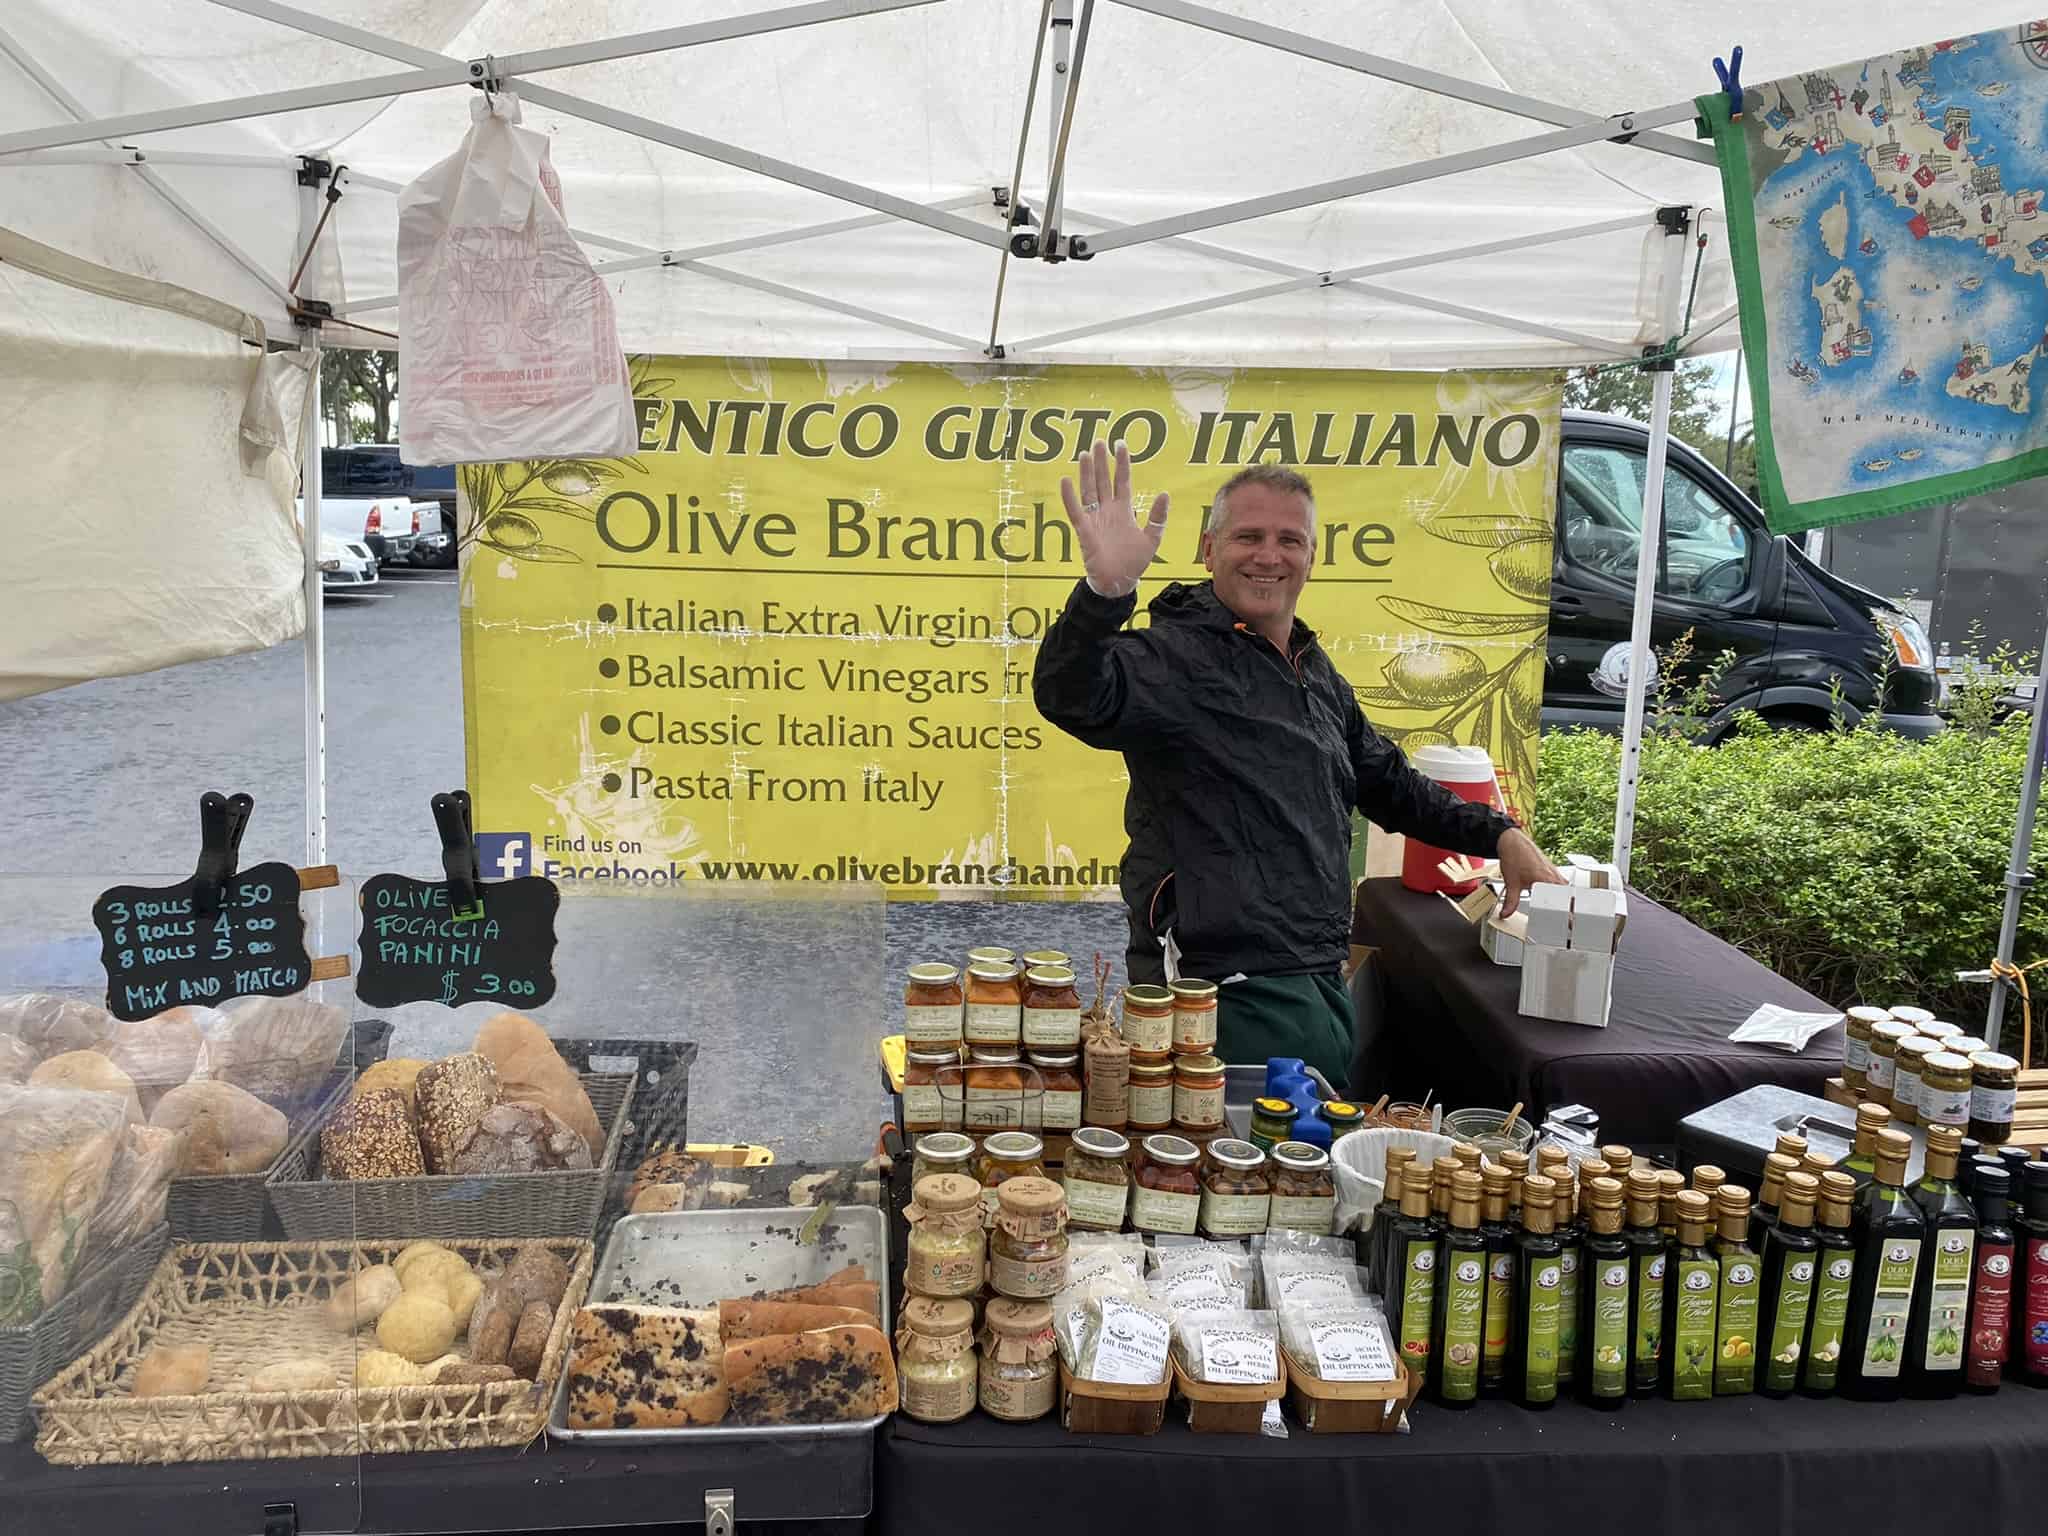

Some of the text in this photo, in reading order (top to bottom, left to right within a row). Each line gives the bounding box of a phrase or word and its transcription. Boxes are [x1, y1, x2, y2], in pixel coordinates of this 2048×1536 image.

[632, 399, 1540, 467] ENTICO GUSTO ITALIANO
[595, 491, 797, 557] Olive
[827, 498, 1073, 563] Branch
[626, 598, 745, 634] Italian
[763, 602, 860, 637] Extra
[876, 604, 991, 648] Virgin
[628, 655, 1030, 703] Balsamic Vinegars fr
[627, 711, 1044, 751] Classic Italian Sauces
[631, 767, 944, 811] Pasta From Italy
[544, 835, 642, 854] Find us on
[543, 859, 687, 888] Facebook
[700, 856, 1120, 886] www.olivebranchandm
[107, 902, 131, 924] 3
[134, 899, 193, 921] ROLLS
[373, 914, 501, 940] FOCACCIA
[114, 926, 127, 945] 6
[136, 920, 196, 942] ROLLS
[118, 949, 135, 968] 8
[142, 944, 197, 965] ROLLS
[179, 977, 221, 1001] AND
[235, 967, 298, 993] MATCH
[433, 969, 461, 1005] $
